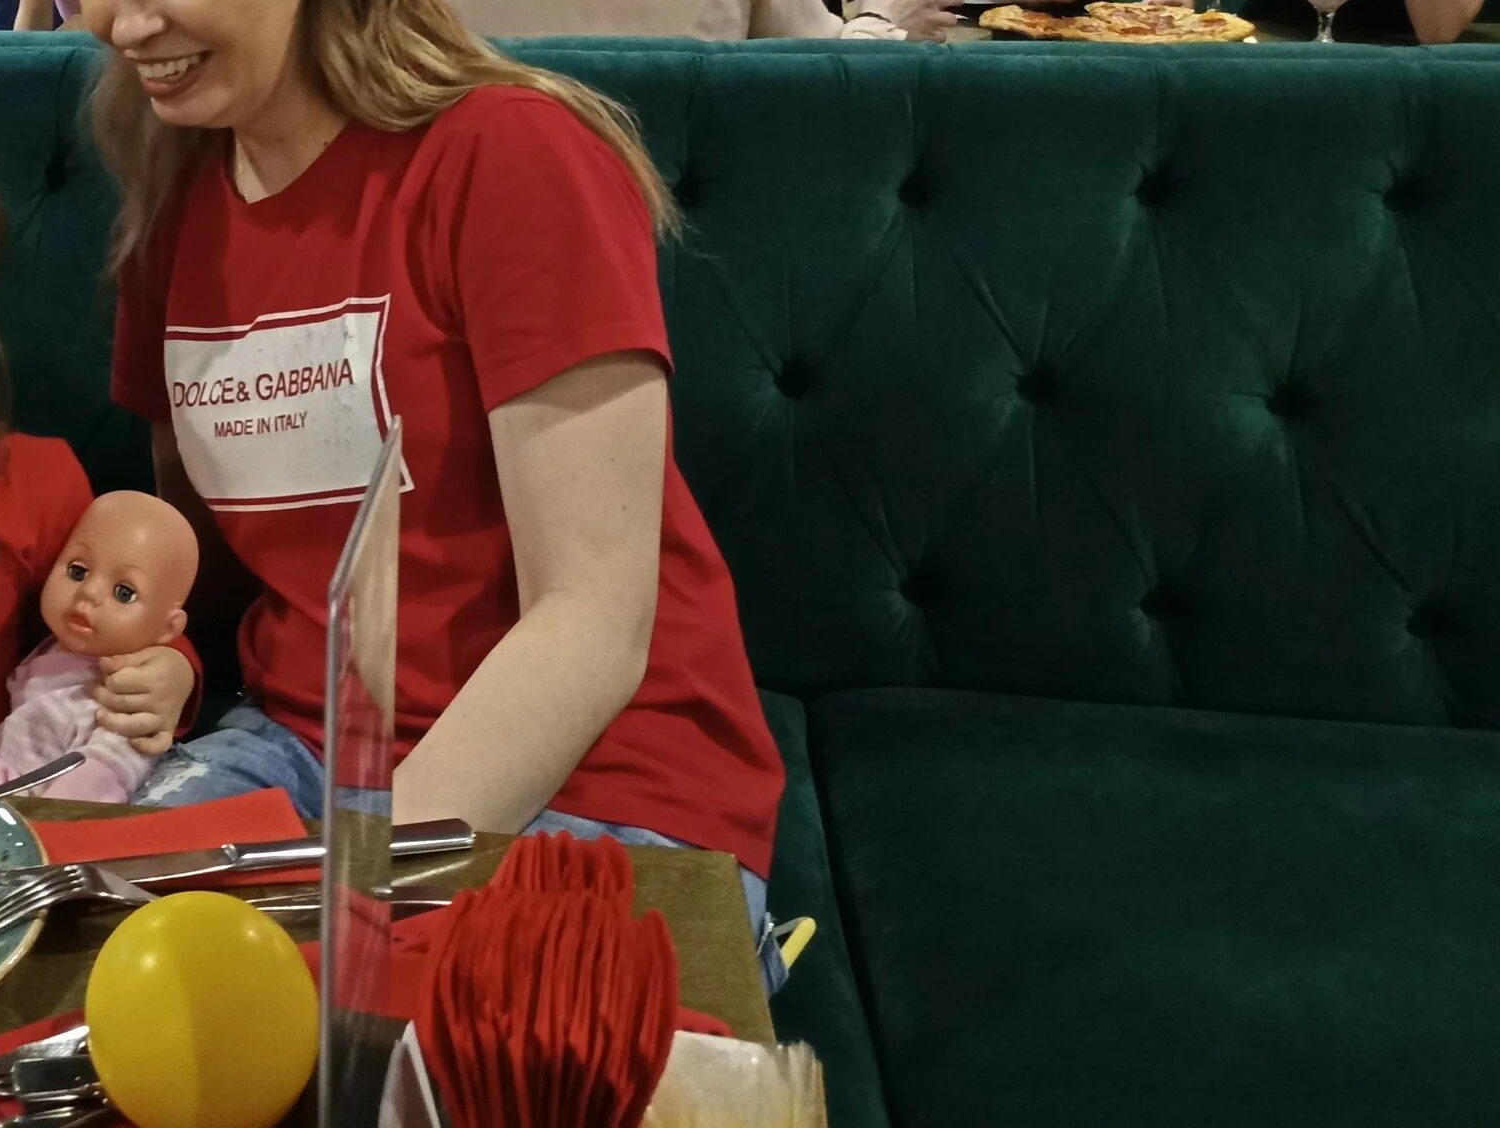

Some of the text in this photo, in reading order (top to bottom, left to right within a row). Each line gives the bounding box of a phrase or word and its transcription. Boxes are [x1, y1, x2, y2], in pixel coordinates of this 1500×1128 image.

[255, 357, 355, 401] GABBANA
[213, 411, 308, 438] MADE IN ITALY
